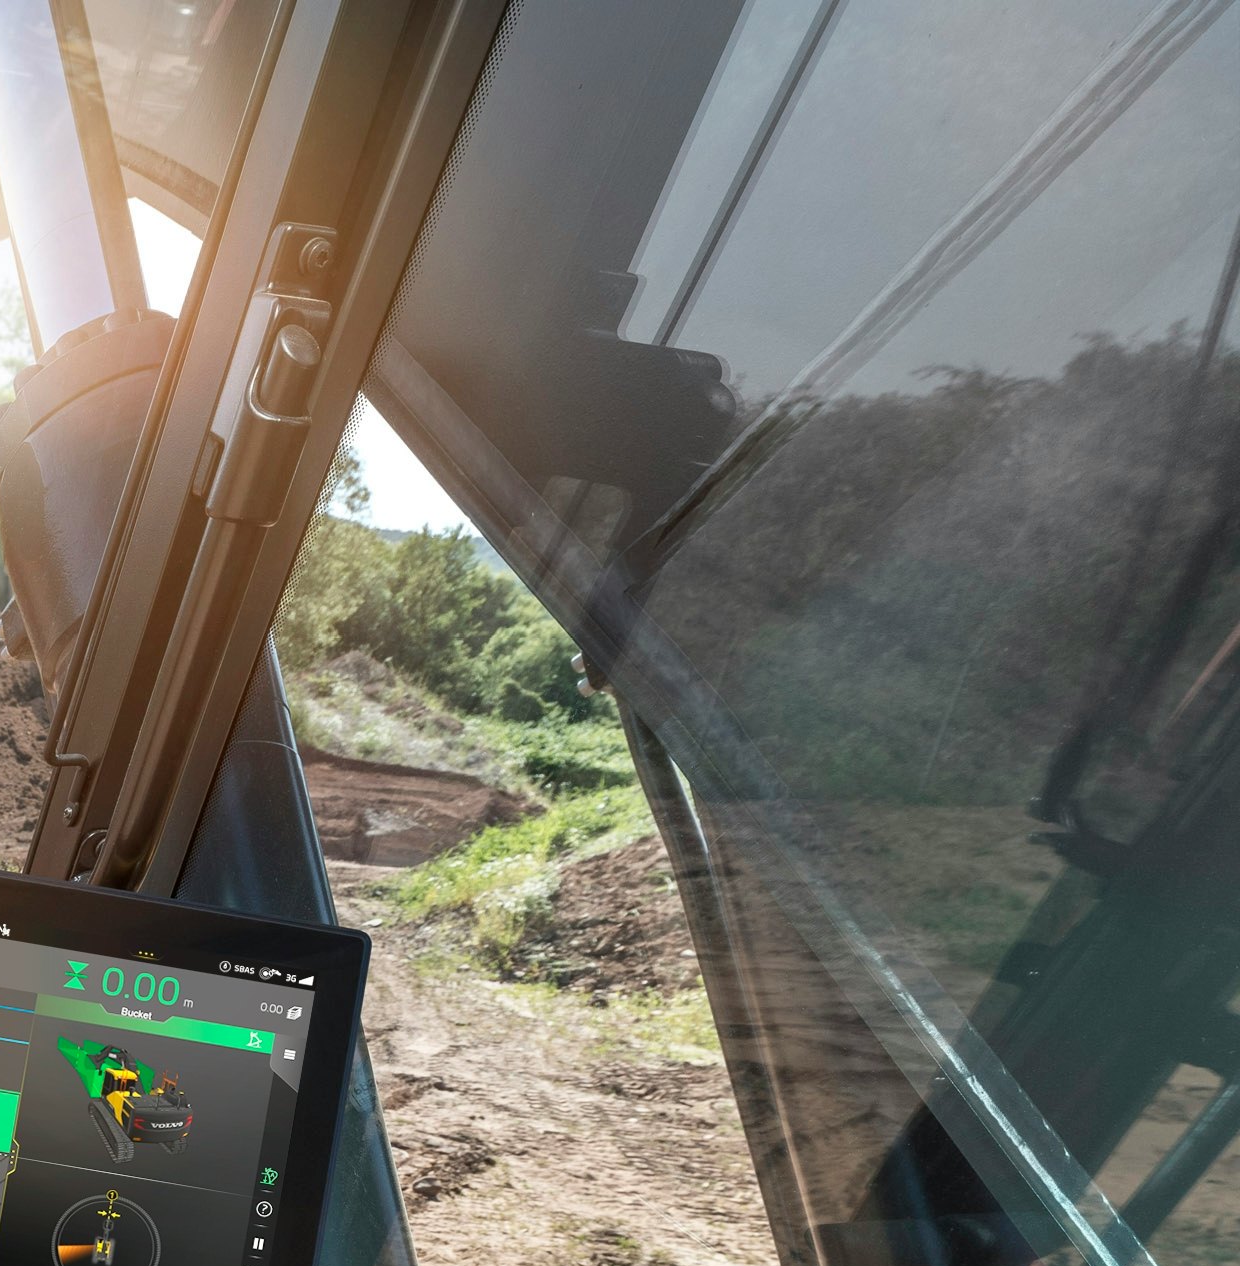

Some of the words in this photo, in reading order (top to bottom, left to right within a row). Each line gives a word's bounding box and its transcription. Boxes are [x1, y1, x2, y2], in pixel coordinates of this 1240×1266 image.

[234, 964, 255, 975] SBAS
[285, 973, 297, 983] 3G
[102, 967, 180, 1006] 0.00
[183, 999, 194, 1008] m
[121, 1007, 153, 1020] Bucket
[260, 1002, 284, 1014] 0.00
[151, 1121, 183, 1129] VOLVO
